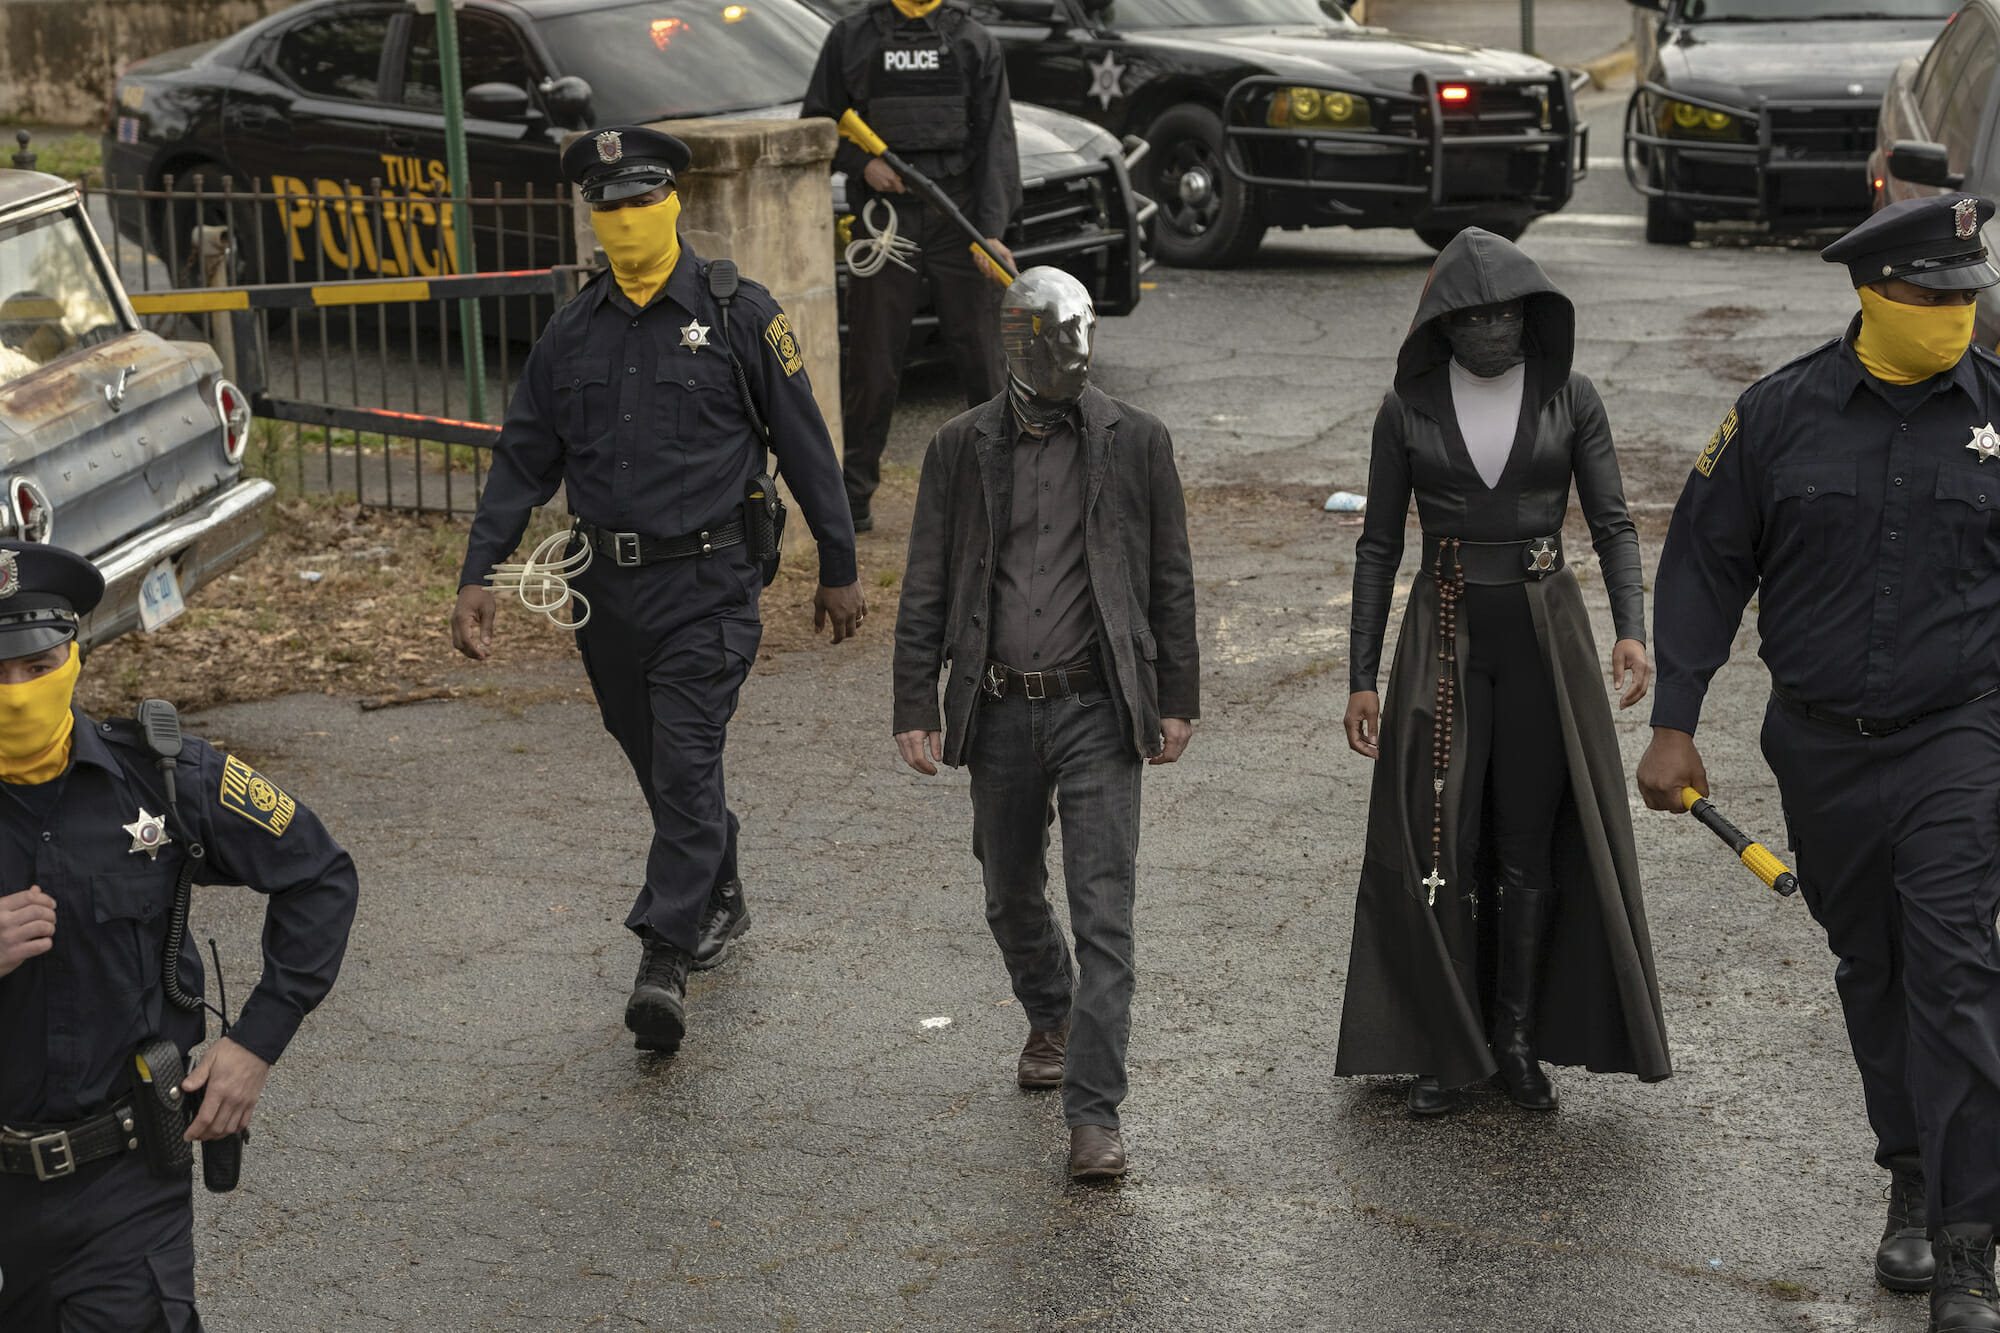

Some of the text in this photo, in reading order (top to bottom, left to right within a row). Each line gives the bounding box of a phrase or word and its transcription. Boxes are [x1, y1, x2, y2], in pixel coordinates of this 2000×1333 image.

[884, 50, 940, 70] POLICE
[381, 154, 452, 194] TULS
[768, 313, 791, 346] TULS
[223, 757, 253, 806] TULS
